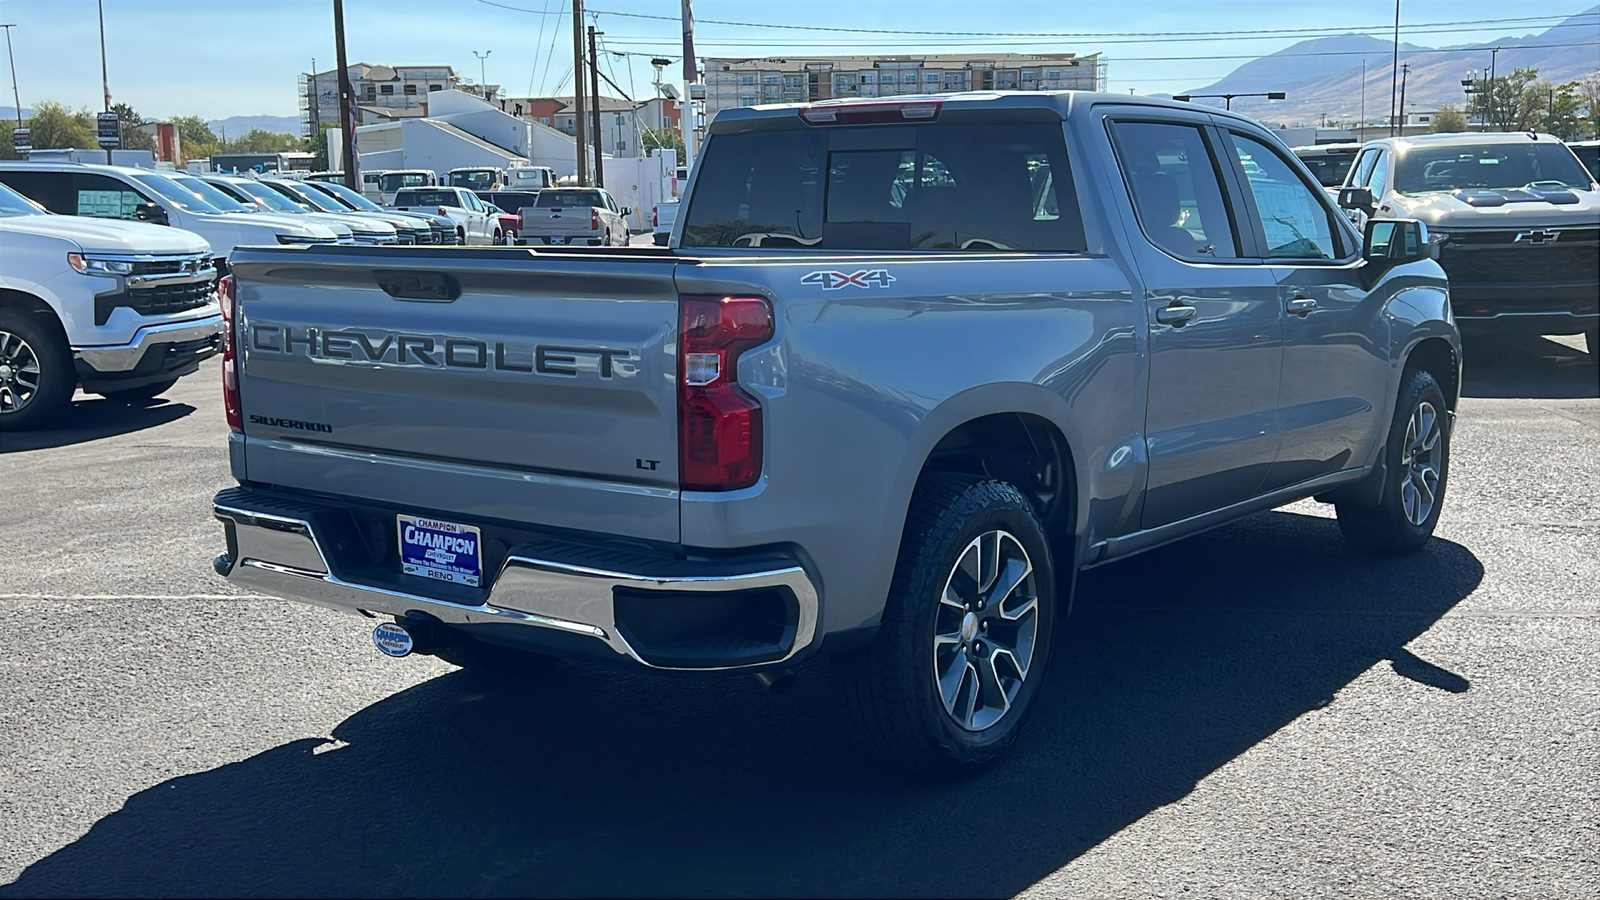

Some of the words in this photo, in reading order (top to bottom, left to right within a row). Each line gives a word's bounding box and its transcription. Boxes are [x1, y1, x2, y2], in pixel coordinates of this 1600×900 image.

[252, 325, 631, 378] CHEVROLET
[250, 414, 332, 433] SILVERADO
[636, 458, 660, 471] LT
[418, 519, 457, 532] CHAMPION
[404, 525, 475, 555] CHAMPION
[427, 551, 454, 561] CHEVROLET
[428, 569, 453, 581] RENO
